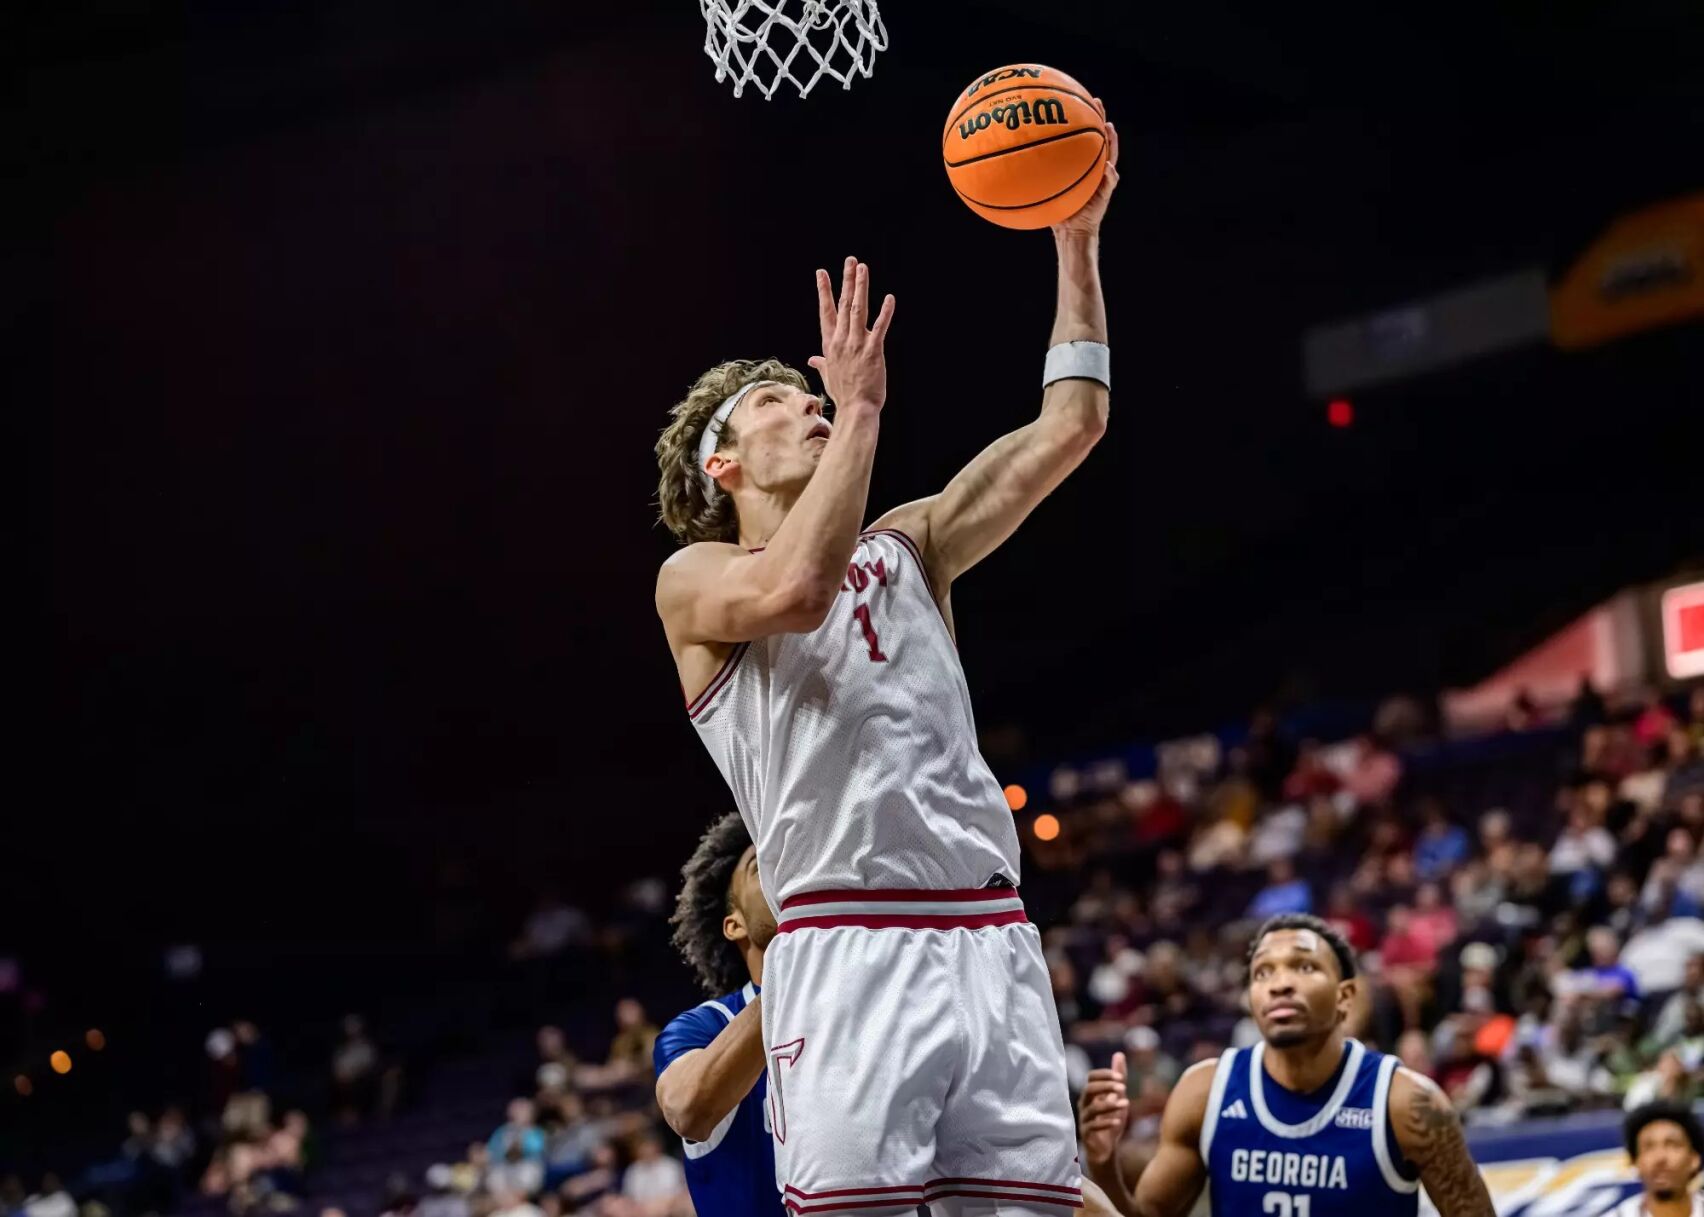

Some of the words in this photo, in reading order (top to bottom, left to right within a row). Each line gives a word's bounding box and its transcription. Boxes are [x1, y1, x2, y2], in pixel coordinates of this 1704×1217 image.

[966, 67, 1042, 97] NCAA
[959, 98, 1069, 140] Wilson
[840, 556, 888, 593] OY
[853, 603, 888, 662] 1
[1231, 1148, 1348, 1190] GEORGIA
